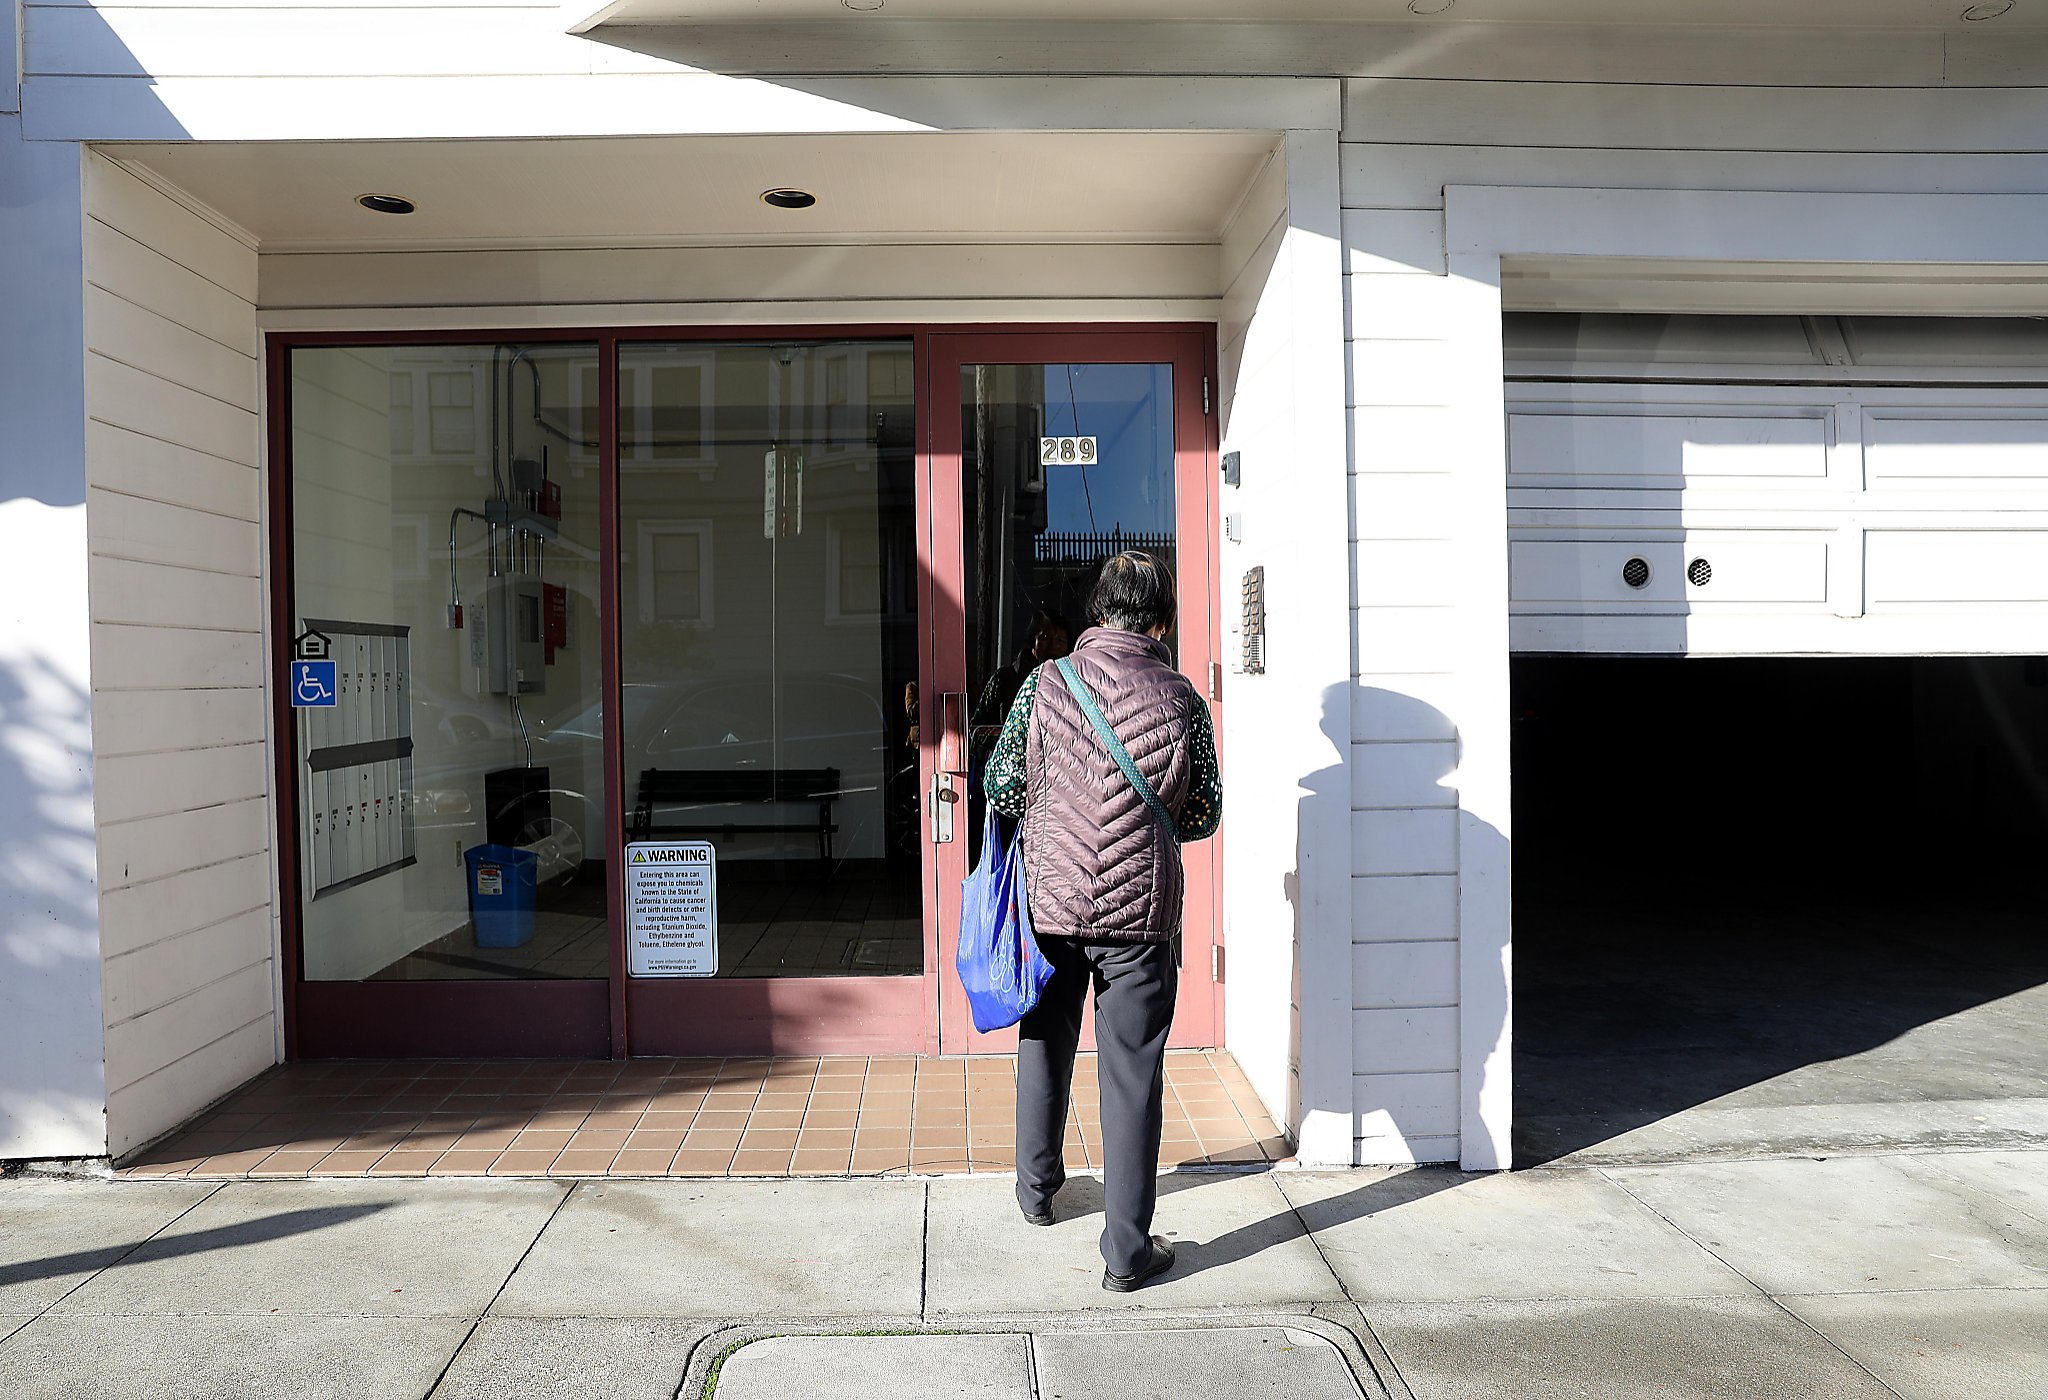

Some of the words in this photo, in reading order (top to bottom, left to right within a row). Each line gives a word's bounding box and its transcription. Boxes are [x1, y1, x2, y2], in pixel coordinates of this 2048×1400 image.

[1042, 438, 1095, 462] 289
[648, 849, 707, 862] WARNING
[640, 871, 663, 879] Entering
